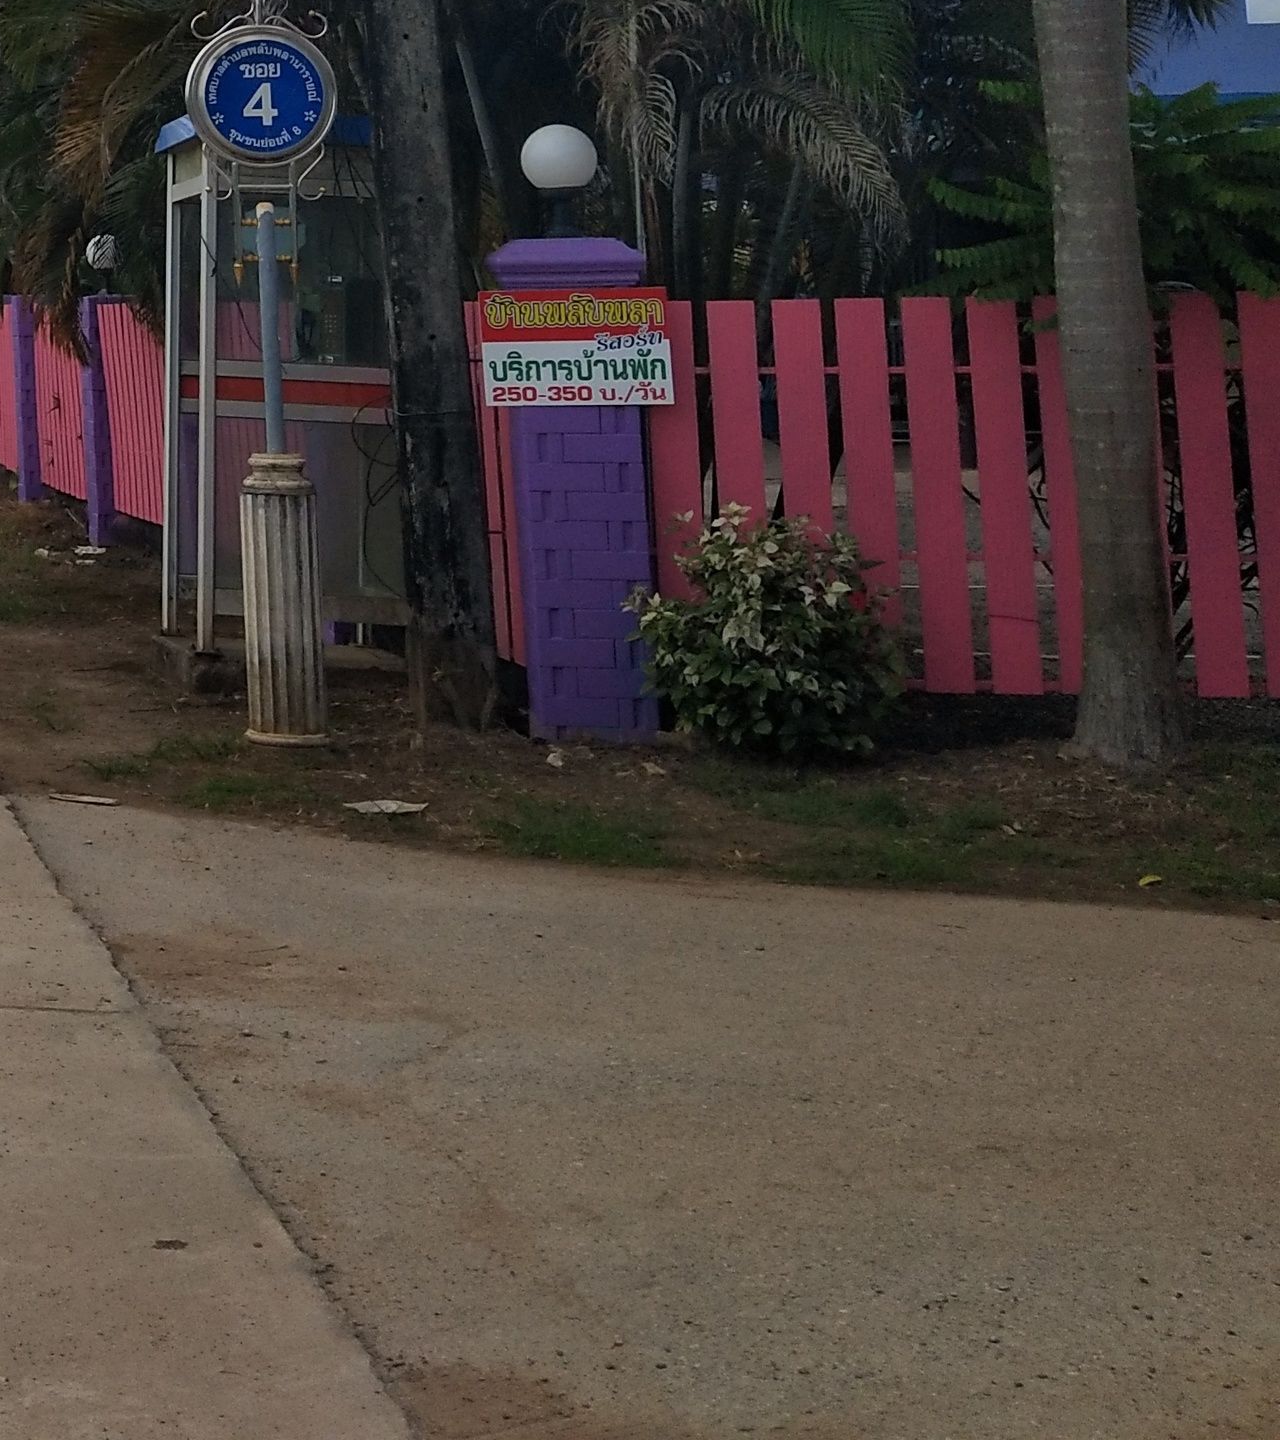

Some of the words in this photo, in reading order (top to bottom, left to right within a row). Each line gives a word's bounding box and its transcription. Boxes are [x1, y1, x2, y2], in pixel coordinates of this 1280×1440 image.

[208, 42, 322, 105] เทศบาลตำบลพลับพลานารายณ์
[239, 62, 281, 79] ซอย
[242, 82, 279, 126] 4
[228, 127, 292, 148] ชุมชนย่อยที่
[292, 125, 302, 136] 8
[485, 293, 665, 329] บ้านพลับพลา
[596, 326, 663, 352] รีสอร์ท
[489, 348, 667, 383] บริการบ้านพัก
[492, 386, 593, 403] 250-350
[599, 382, 667, 403] บ./วัน
